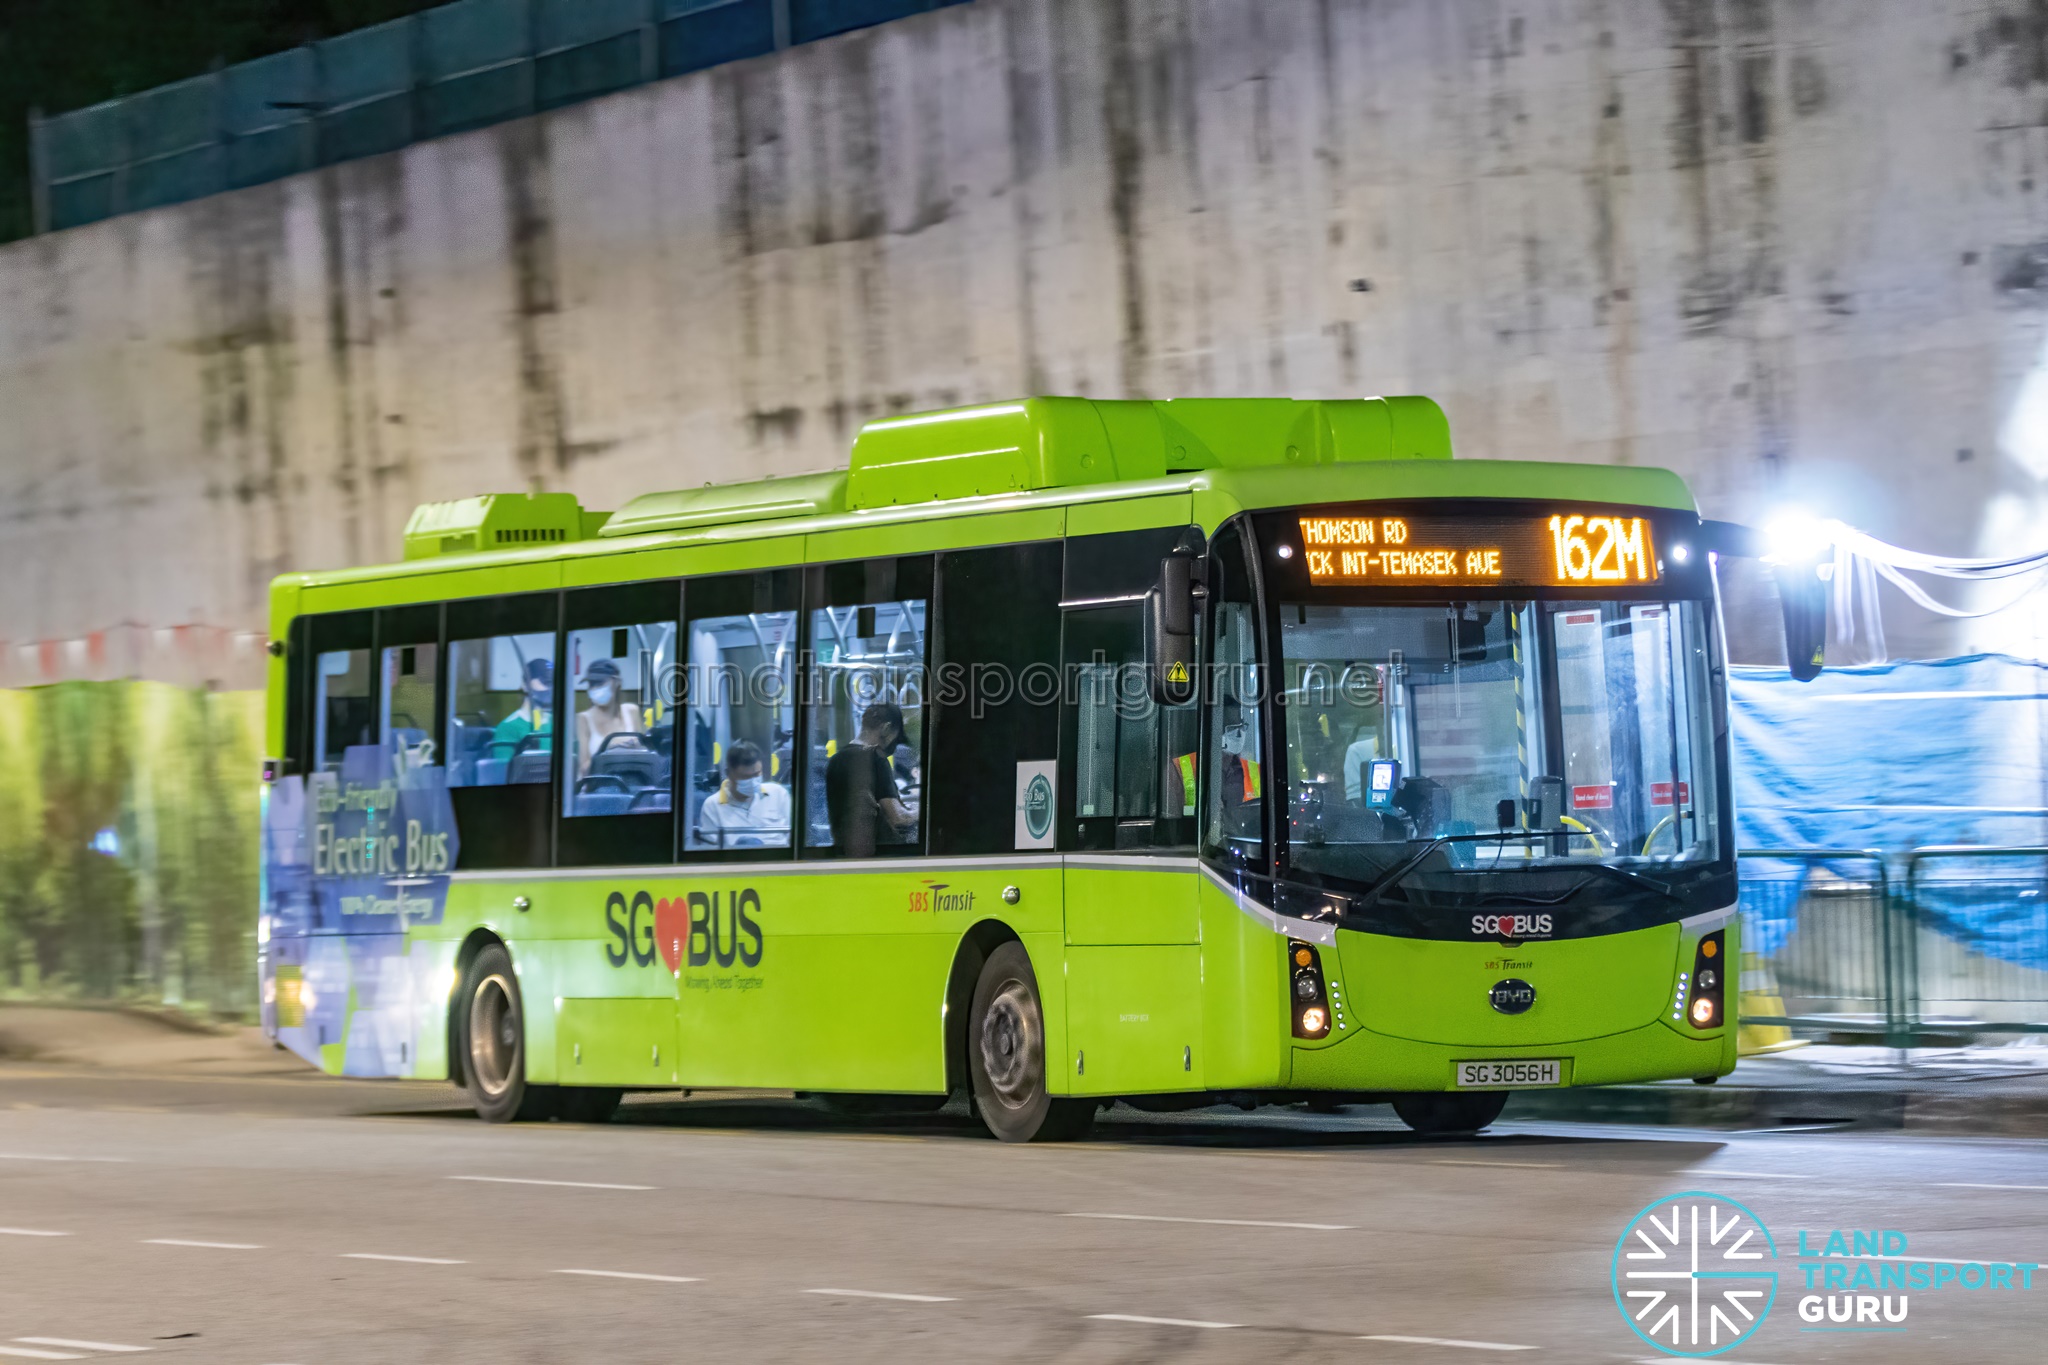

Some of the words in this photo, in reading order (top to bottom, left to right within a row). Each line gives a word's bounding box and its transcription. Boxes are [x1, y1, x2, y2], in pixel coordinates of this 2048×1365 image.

[1383, 520, 1408, 544] RD
[1549, 514, 1648, 580] 162M
[1305, 551, 1334, 575] CK
[1341, 551, 1458, 575] INT-TEMASEK
[1466, 551, 1502, 575] AVE
[314, 821, 399, 875] Electric
[406, 819, 449, 872] Bus
[908, 891, 928, 912] SBS
[928, 884, 976, 916] Transit
[605, 890, 656, 968] SG
[688, 888, 763, 968] BUS
[1471, 915, 1499, 934] SG
[1514, 914, 1552, 933] BUS
[1484, 961, 1500, 970] SBS
[1501, 959, 1533, 971] Transit
[1495, 989, 1531, 1004] BYD
